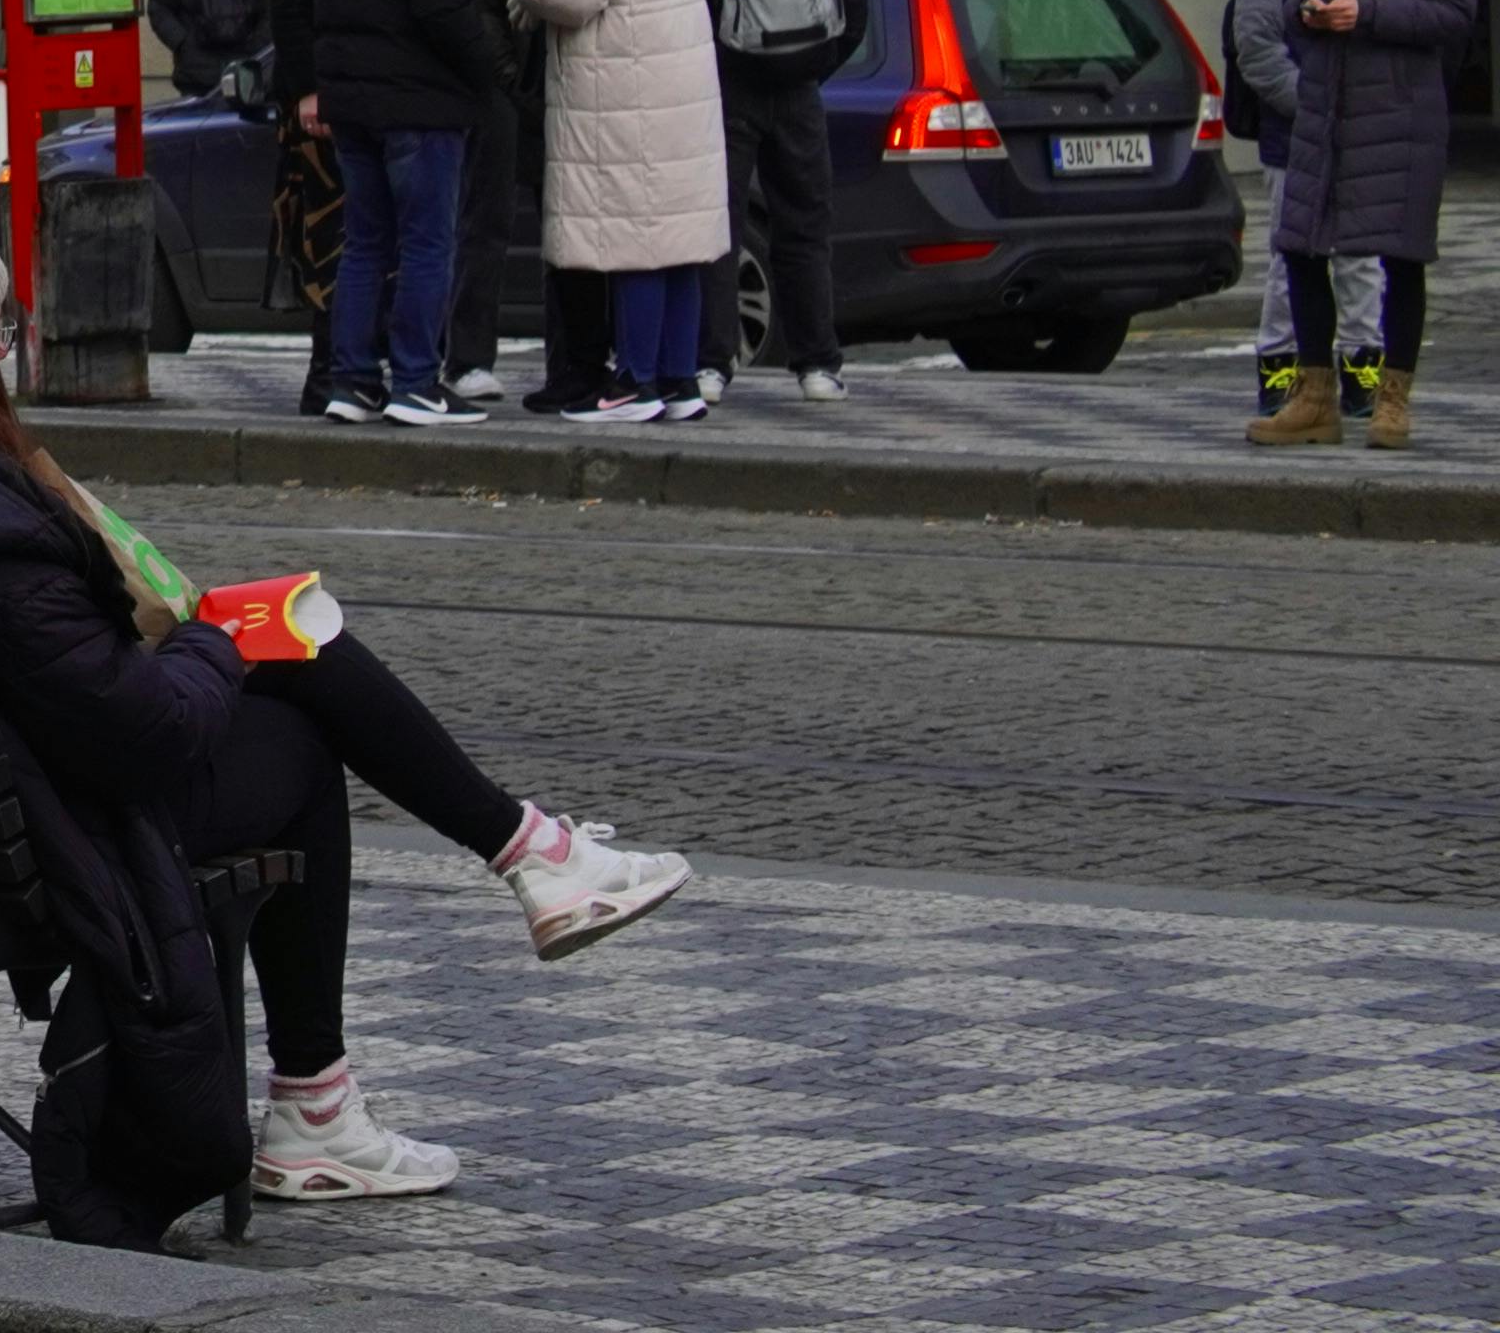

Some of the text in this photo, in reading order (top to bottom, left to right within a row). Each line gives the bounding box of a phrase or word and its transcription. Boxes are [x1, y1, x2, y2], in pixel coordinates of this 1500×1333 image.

[1051, 101, 1158, 116] VOLVO
[1065, 137, 1145, 165] 3AU 1424
